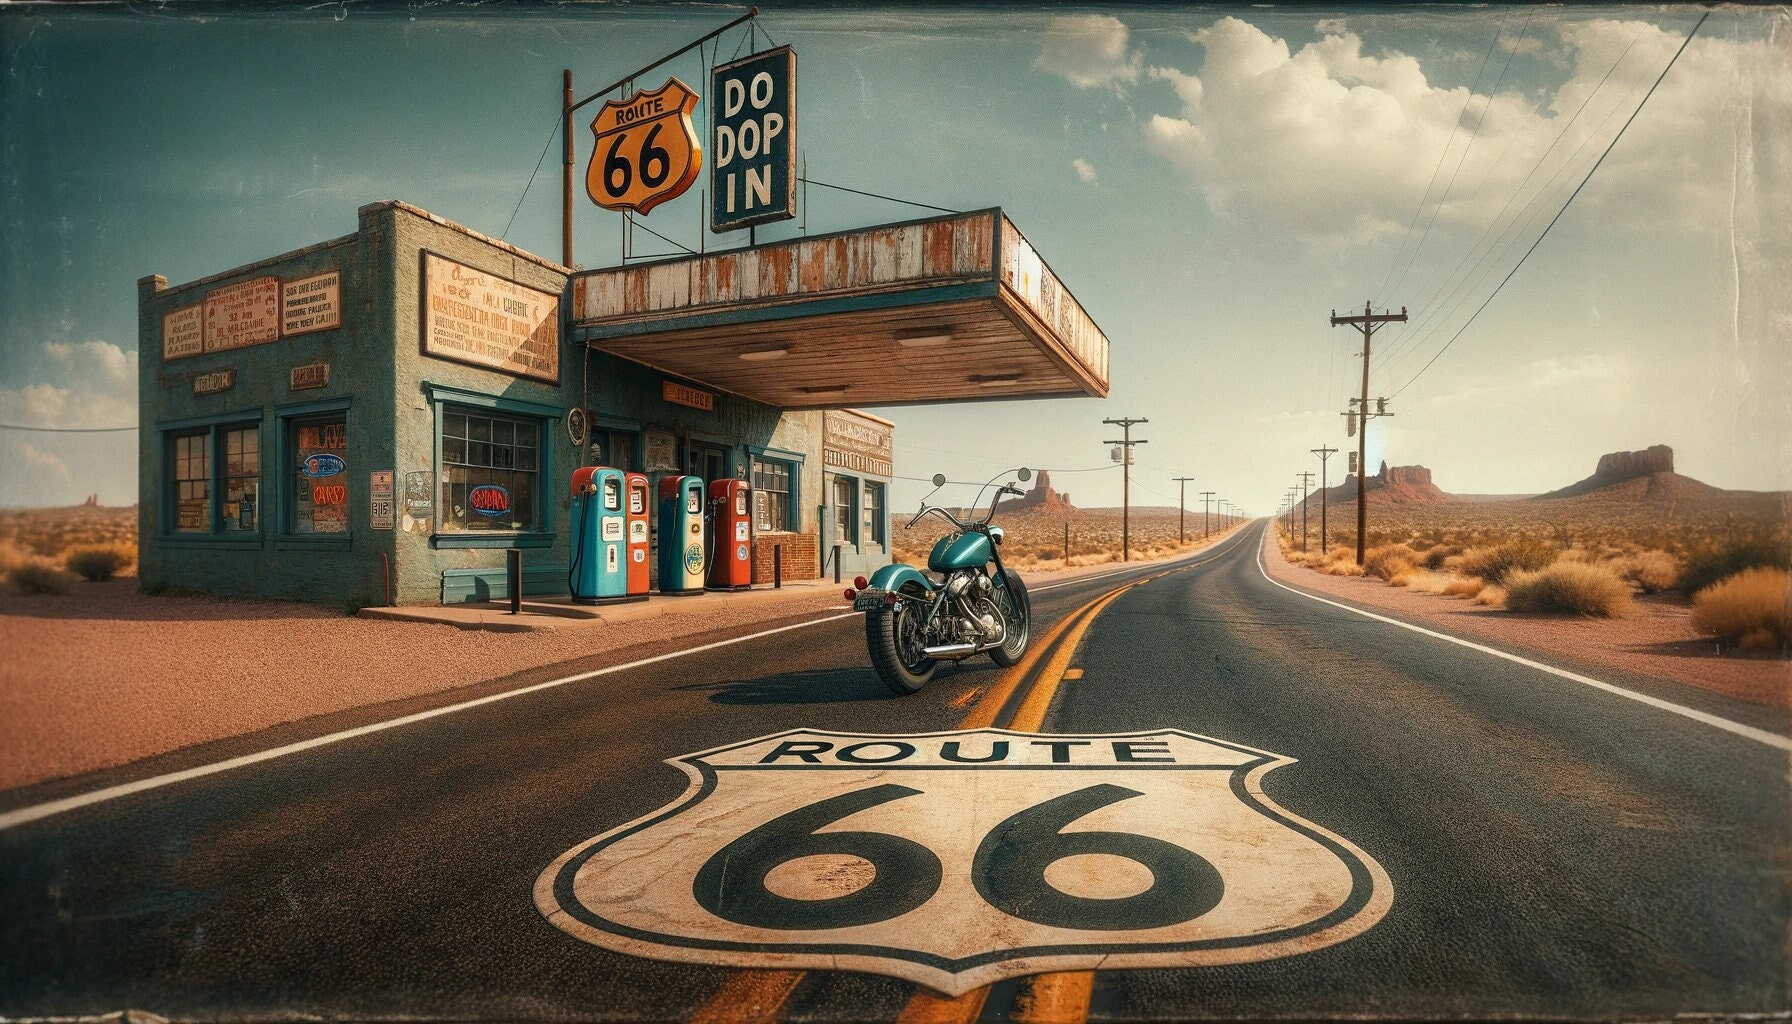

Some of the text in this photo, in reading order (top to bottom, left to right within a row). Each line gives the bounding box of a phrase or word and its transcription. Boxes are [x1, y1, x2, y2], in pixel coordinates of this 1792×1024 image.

[615, 96, 664, 126] ROUTE
[725, 71, 774, 119] DO
[603, 123, 670, 198] 66
[716, 112, 784, 169] DOP
[726, 164, 772, 213] IN
[757, 740, 1177, 764] ROUTE
[692, 782, 1226, 932] 66
